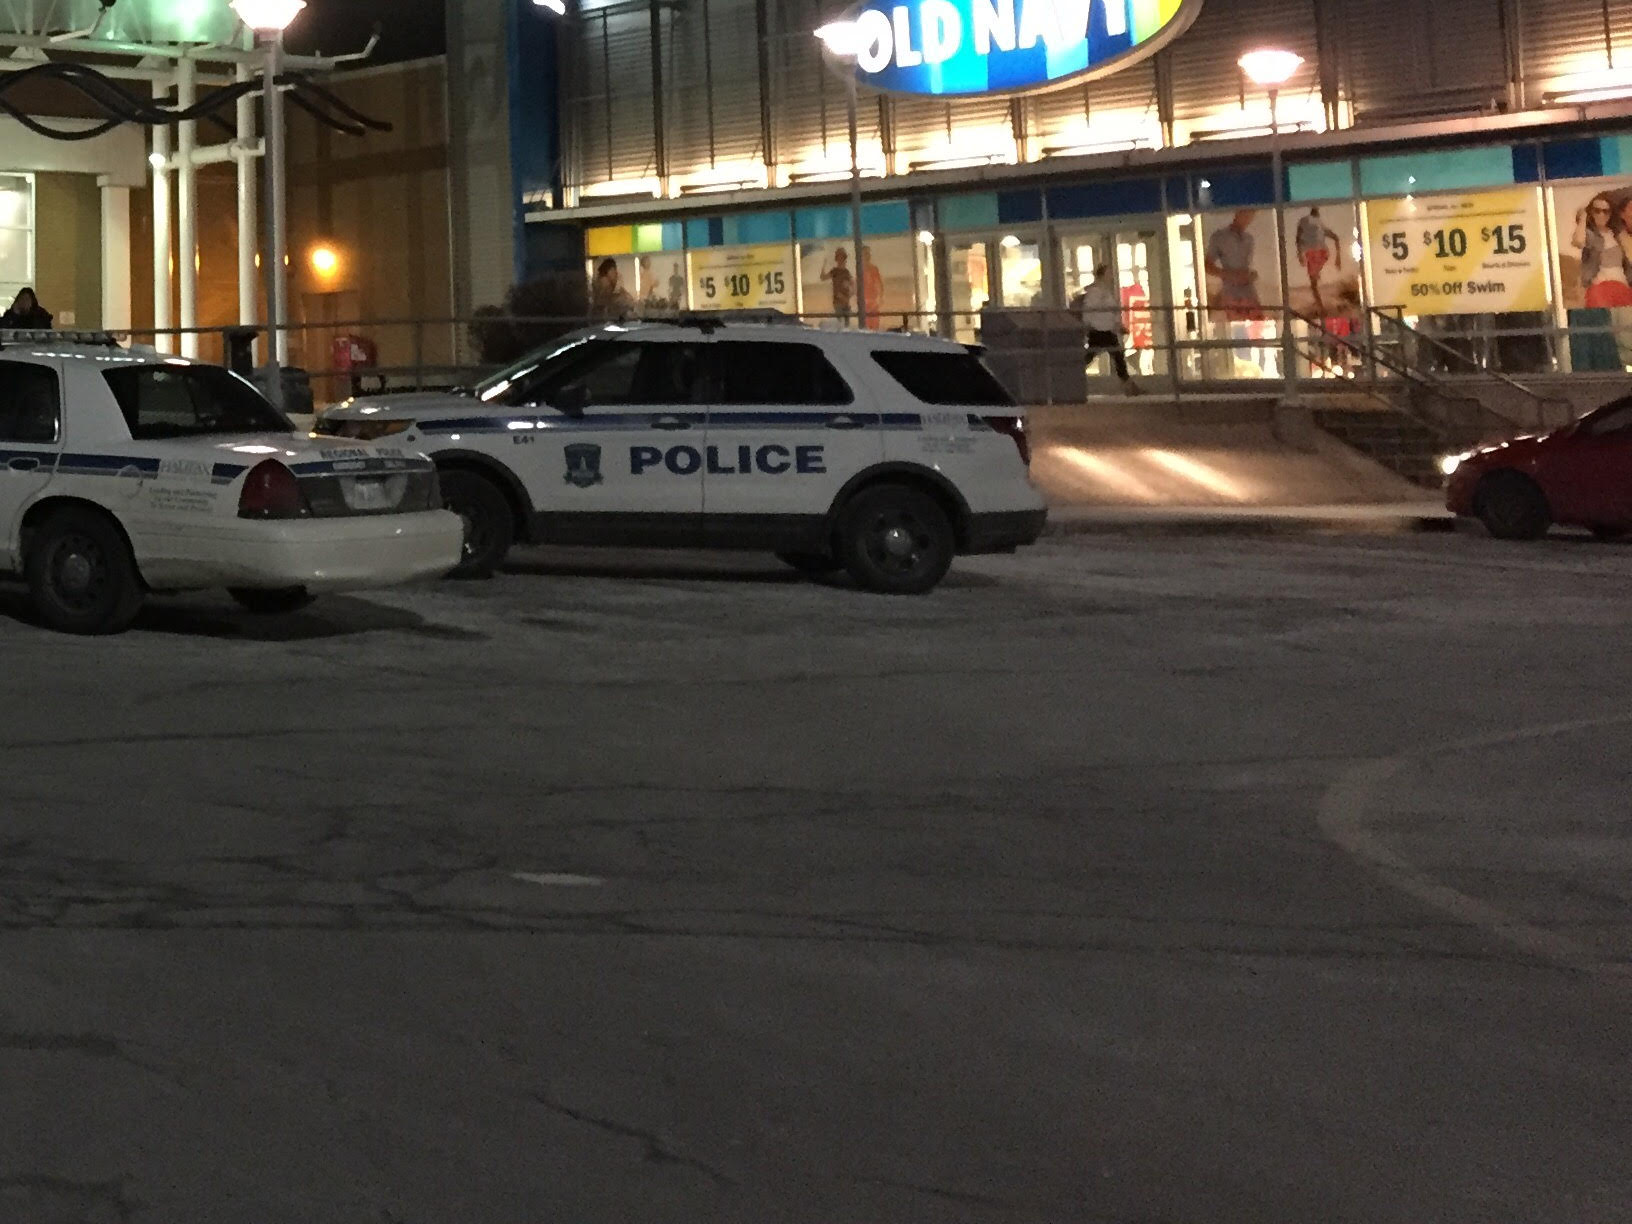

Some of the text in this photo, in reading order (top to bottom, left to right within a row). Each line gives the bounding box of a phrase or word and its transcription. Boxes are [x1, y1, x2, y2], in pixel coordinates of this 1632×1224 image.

[1382, 225, 1527, 261] $5 $10 $15
[1442, 280, 1463, 295] Off
[1467, 281, 1506, 295] Swim
[630, 444, 827, 475] POLICE
